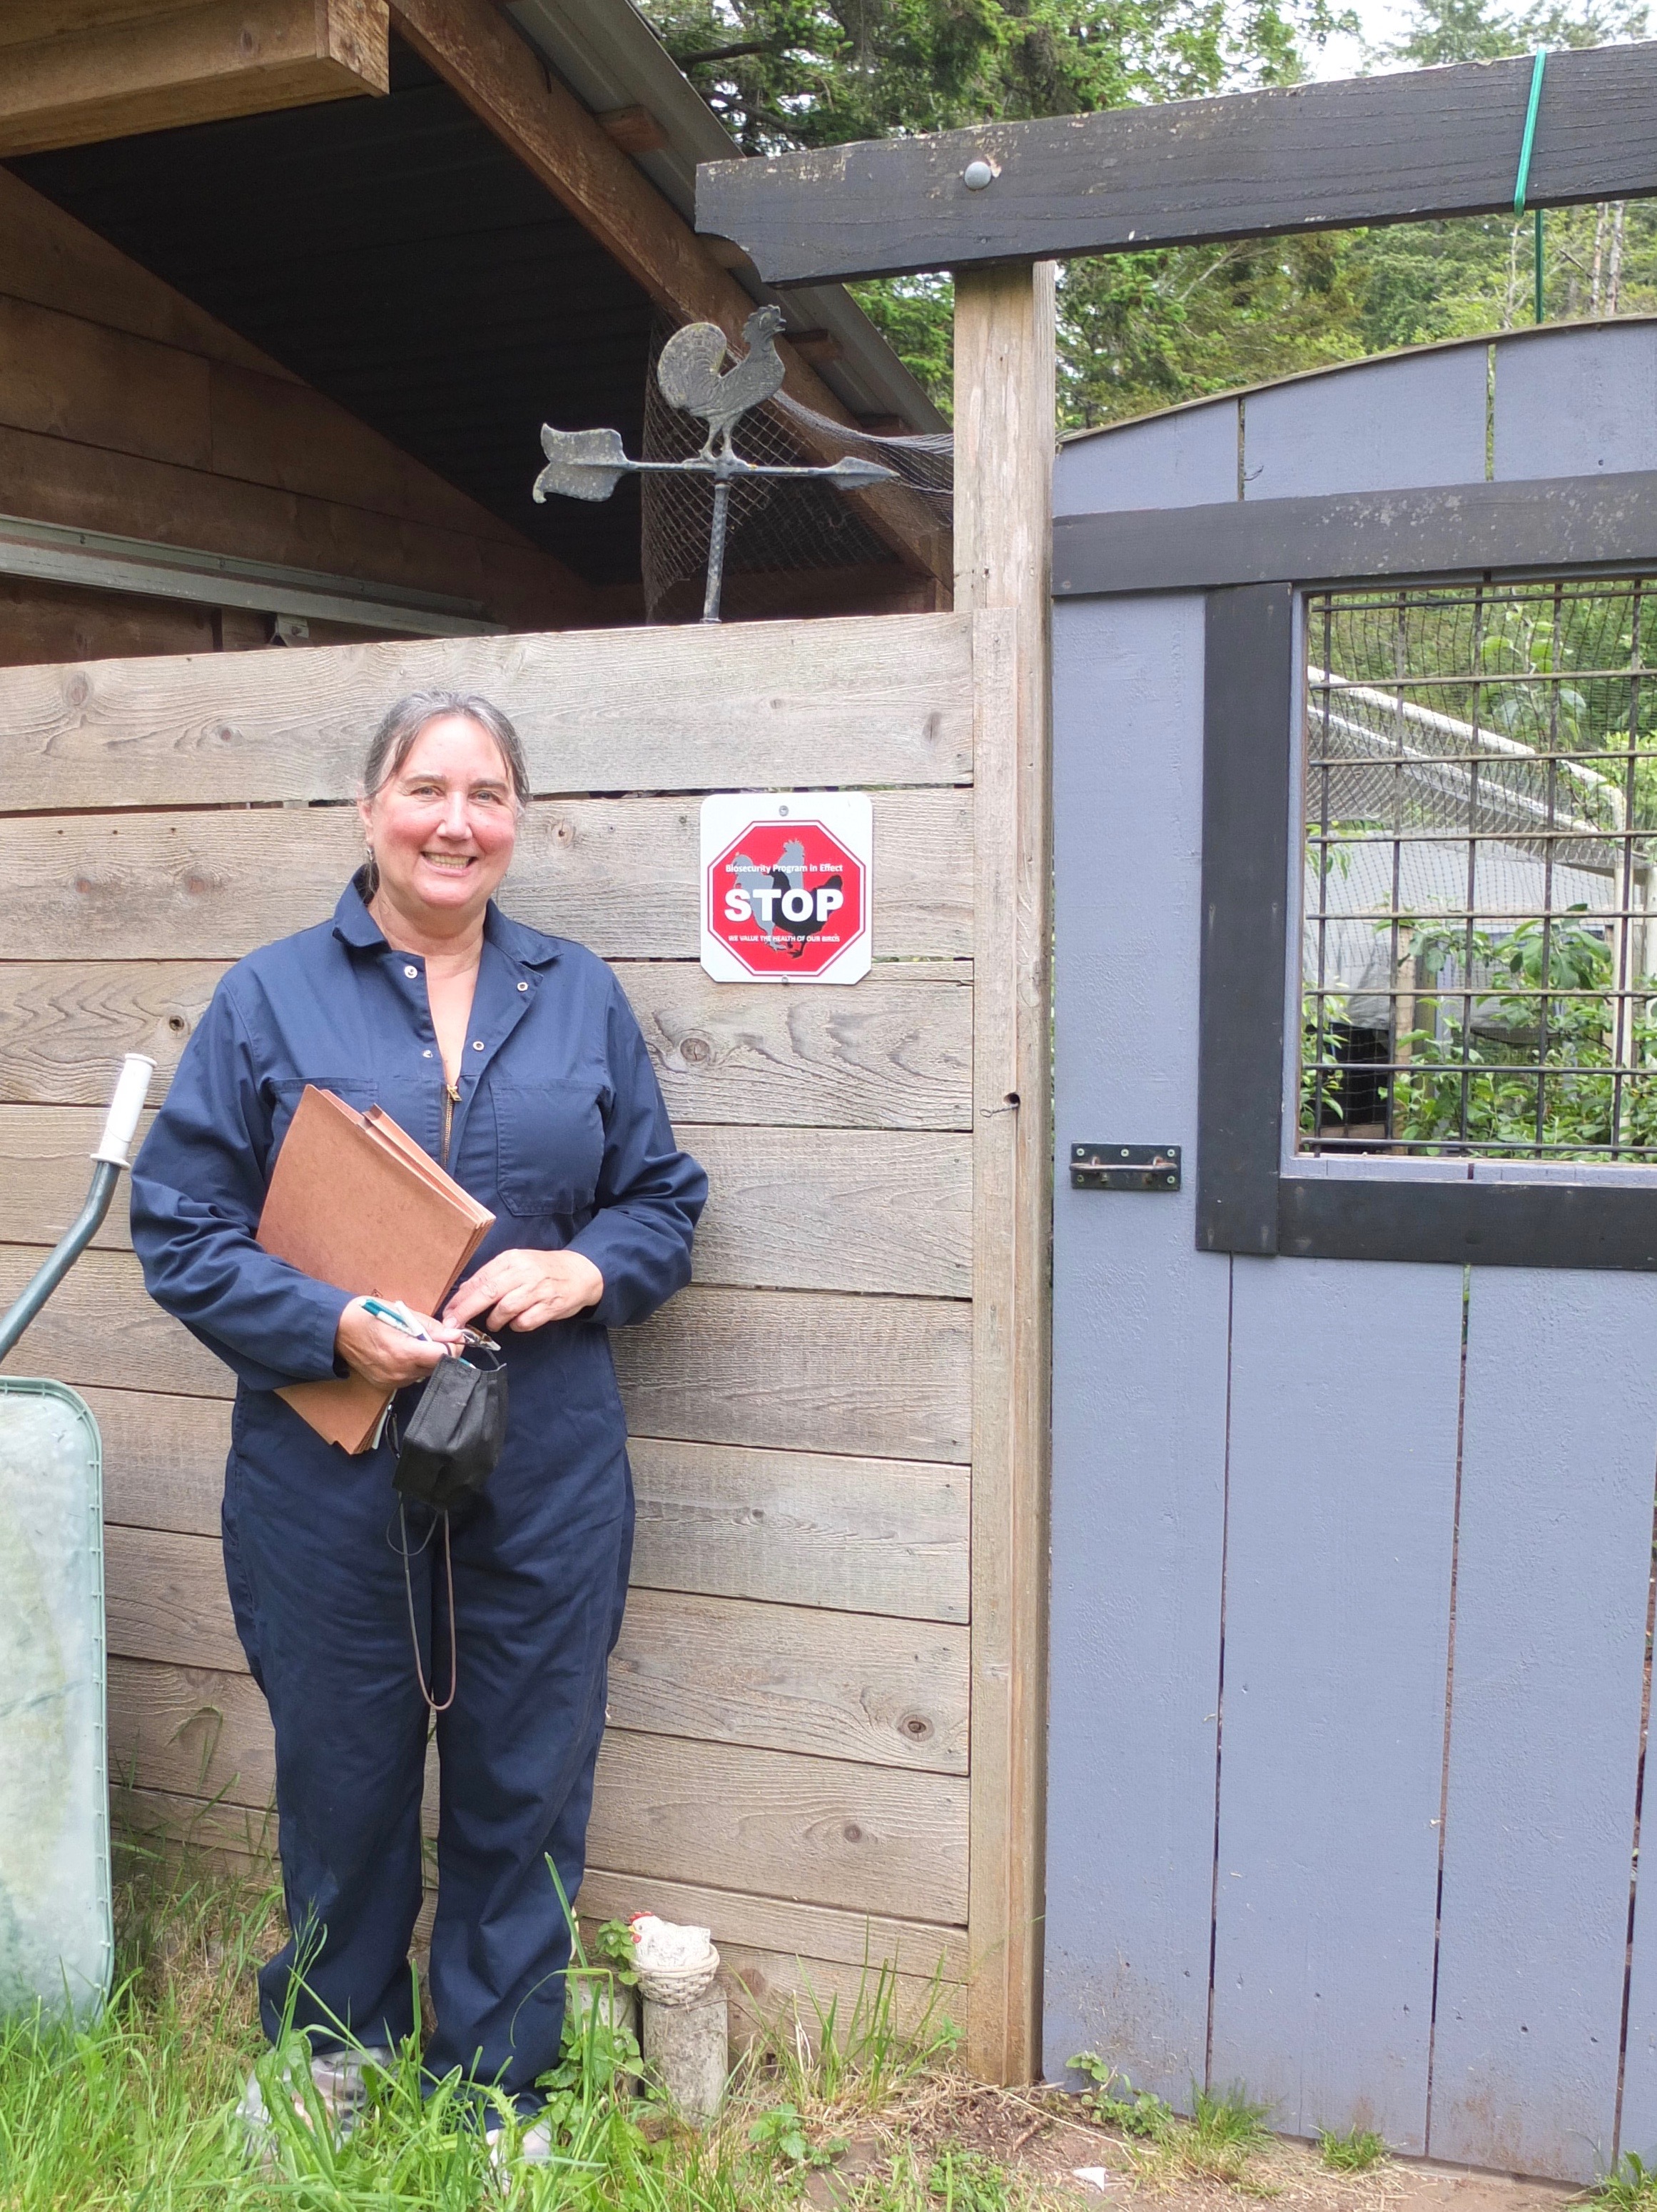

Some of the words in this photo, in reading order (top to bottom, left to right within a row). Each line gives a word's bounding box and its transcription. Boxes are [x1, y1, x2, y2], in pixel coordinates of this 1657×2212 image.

[726, 864, 771, 873] Biosecurity
[773, 864, 807, 873] Program
[724, 889, 844, 922] STOP
